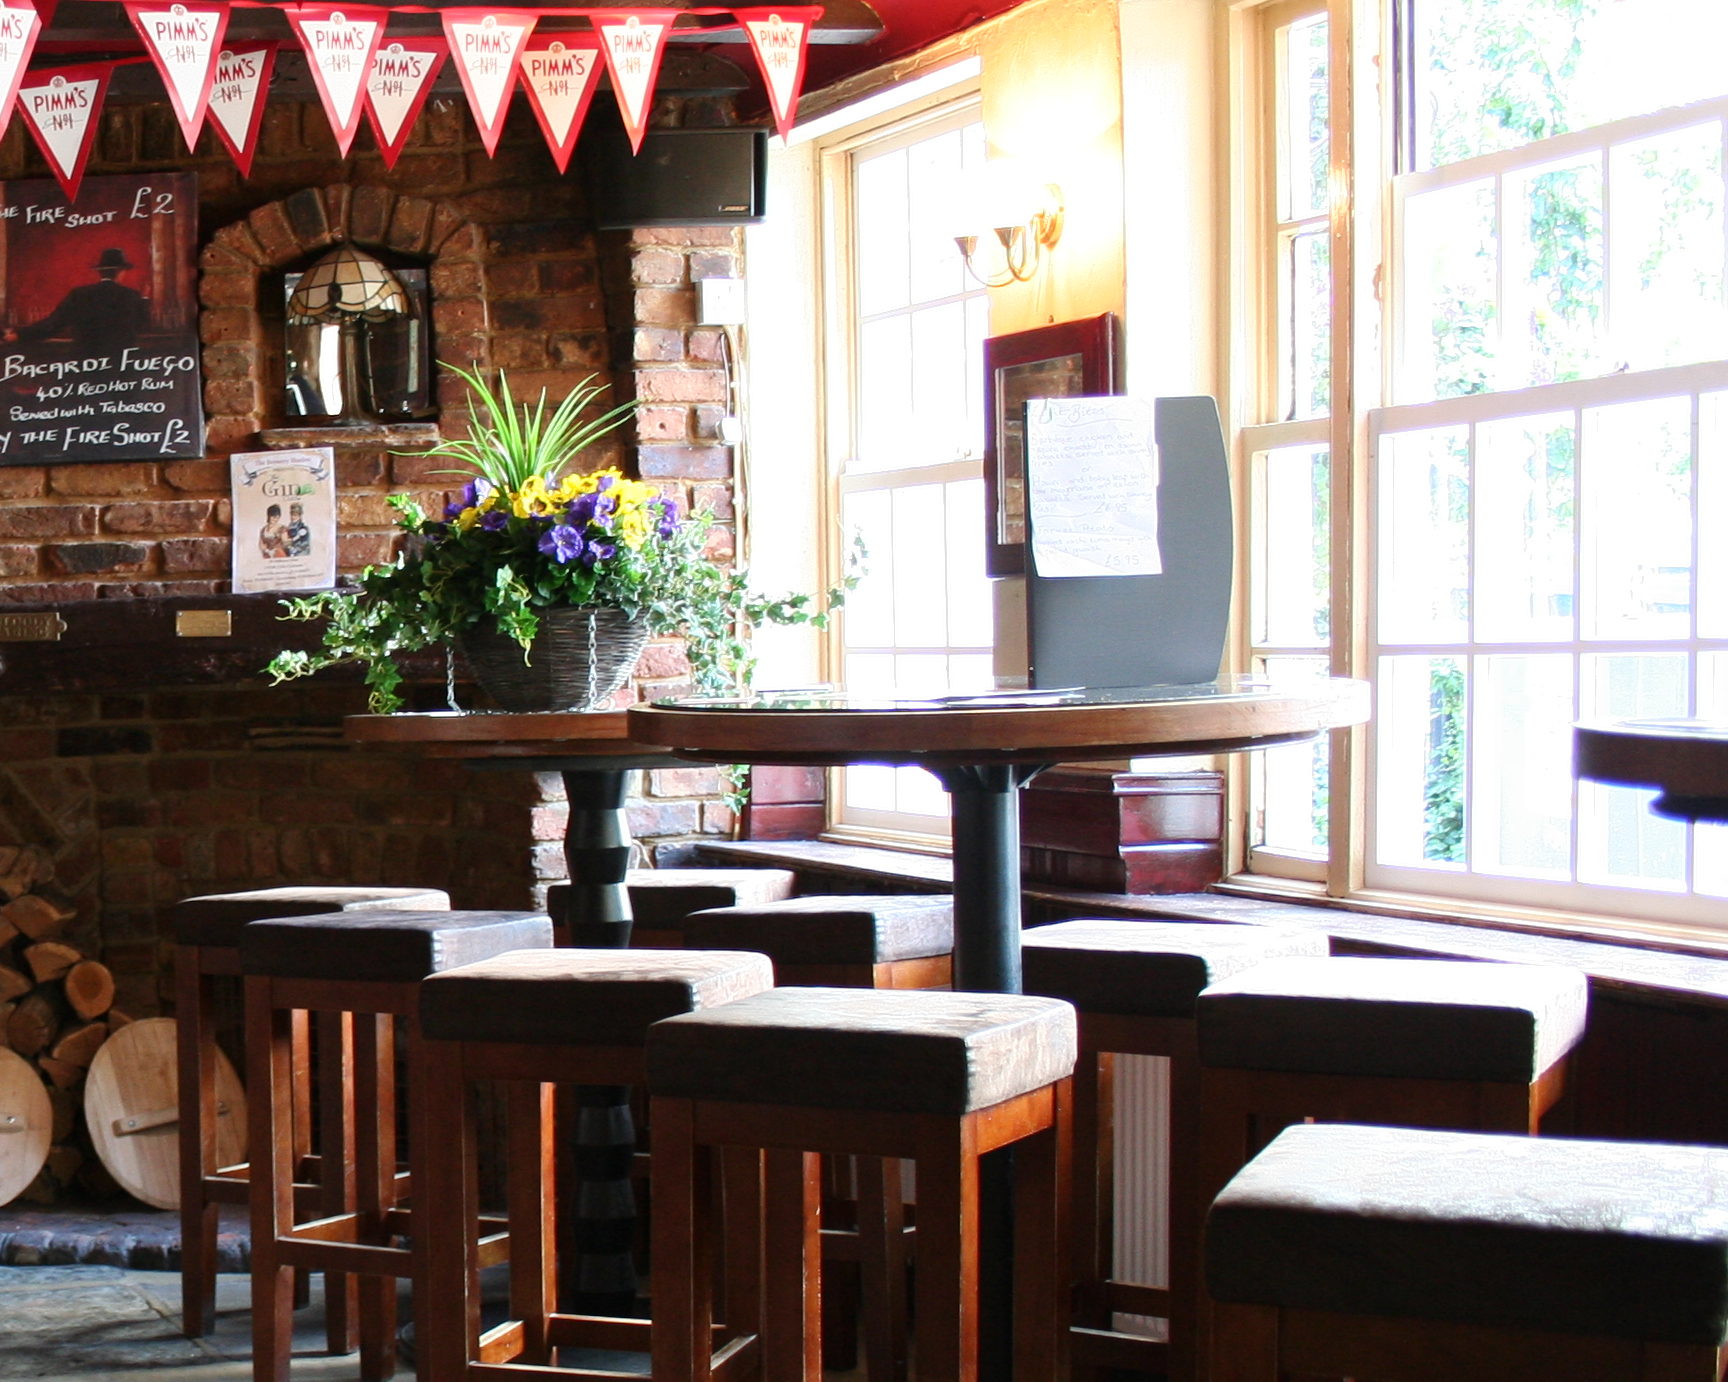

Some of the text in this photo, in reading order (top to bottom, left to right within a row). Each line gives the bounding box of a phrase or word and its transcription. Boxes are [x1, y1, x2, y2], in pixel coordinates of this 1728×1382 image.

[156, 17, 208, 42] PIMM'S
[315, 26, 364, 51] PIMM'S
[614, 30, 651, 53] PIMM'S
[760, 27, 796, 49] PIMM'S
[465, 31, 511, 54] PIMM'S
[214, 57, 256, 83] IMM'S
[531, 54, 586, 78] PIMM'S
[33, 87, 88, 114] PIMM'S
[26, 204, 66, 224] FIRE
[64, 211, 118, 228] SHOT
[129, 186, 175, 220] £2
[120, 347, 195, 377] FUEGO
[141, 377, 174, 391] RUM
[60, 403, 95, 419] with
[99, 400, 166, 414] Tabasco
[20, 429, 59, 445] THE
[63, 426, 111, 452] FIRE
[112, 422, 162, 446] SHOT
[159, 418, 191, 454] £2
